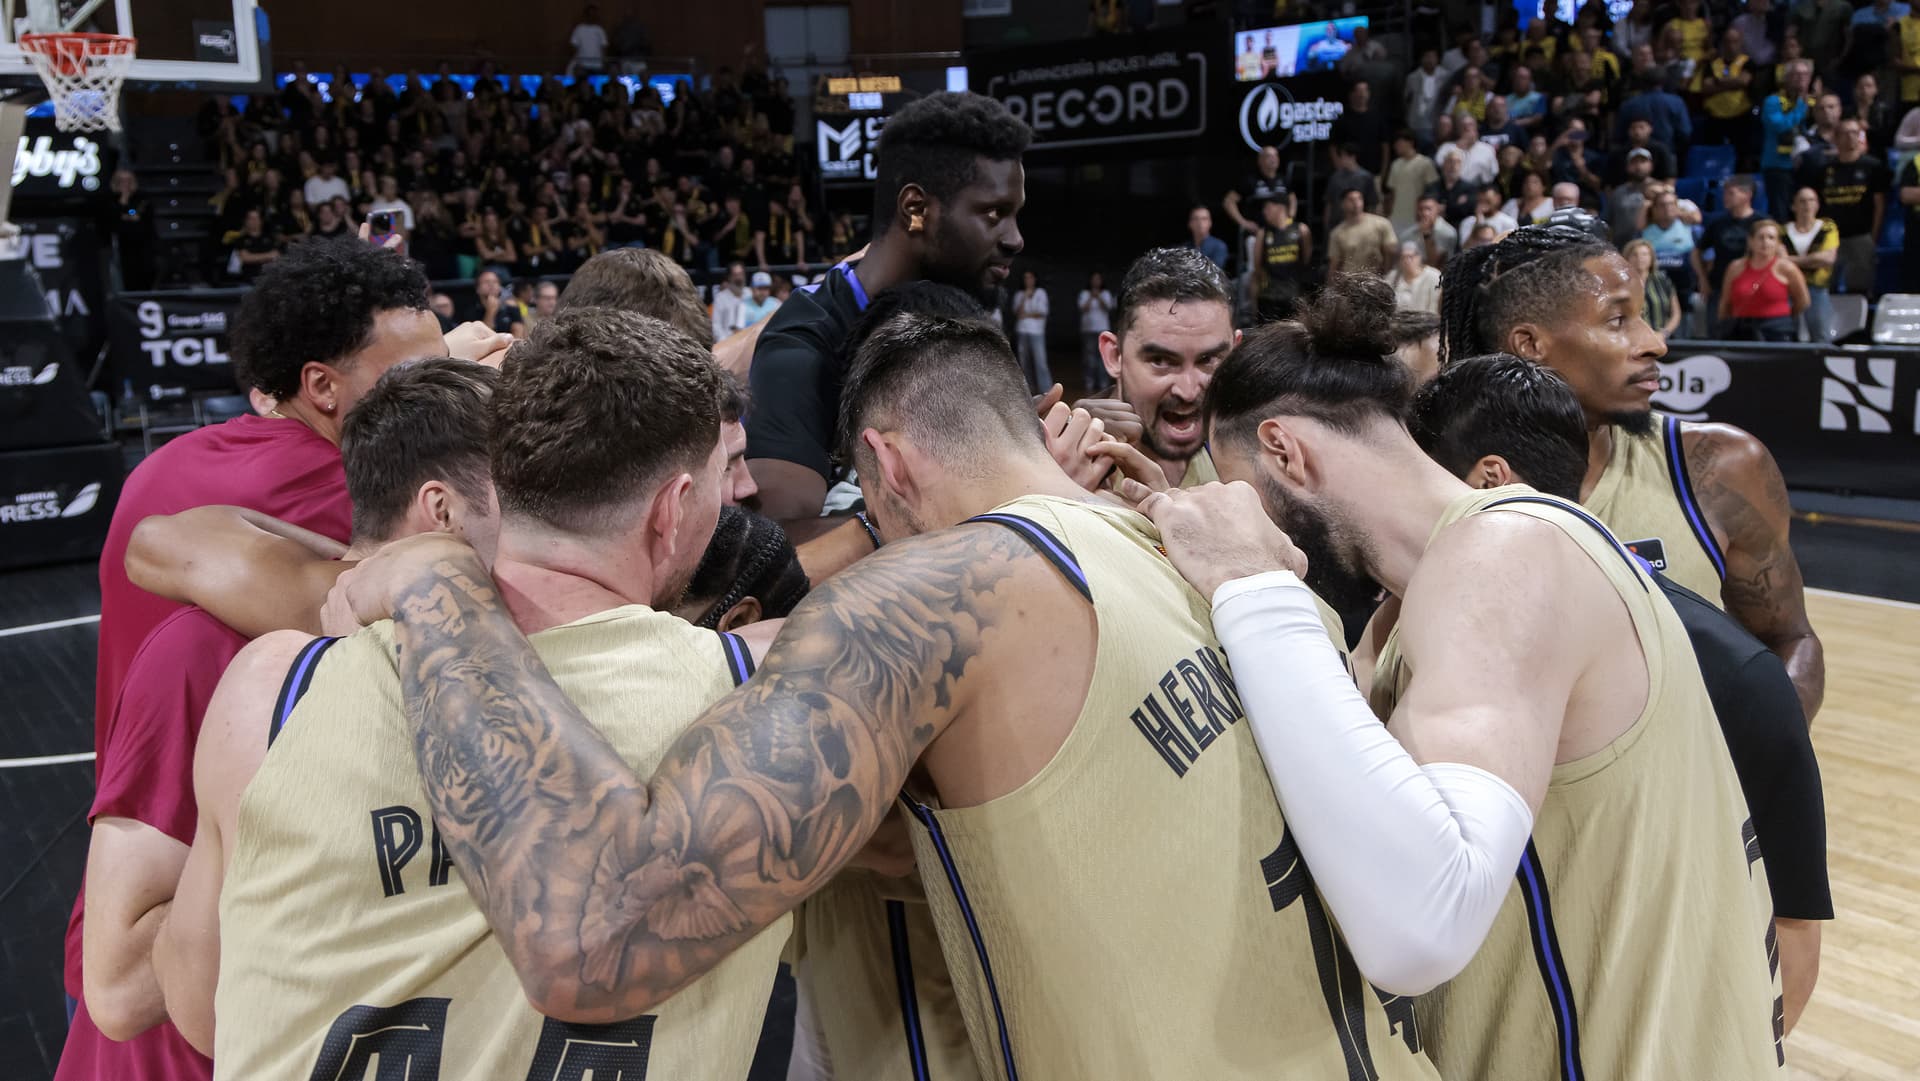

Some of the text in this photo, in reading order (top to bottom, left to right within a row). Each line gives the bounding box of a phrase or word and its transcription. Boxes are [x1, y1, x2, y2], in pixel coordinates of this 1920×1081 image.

[1293, 121, 1332, 142] solar
[140, 337, 232, 367] TCL
[0, 500, 61, 524] RESS
